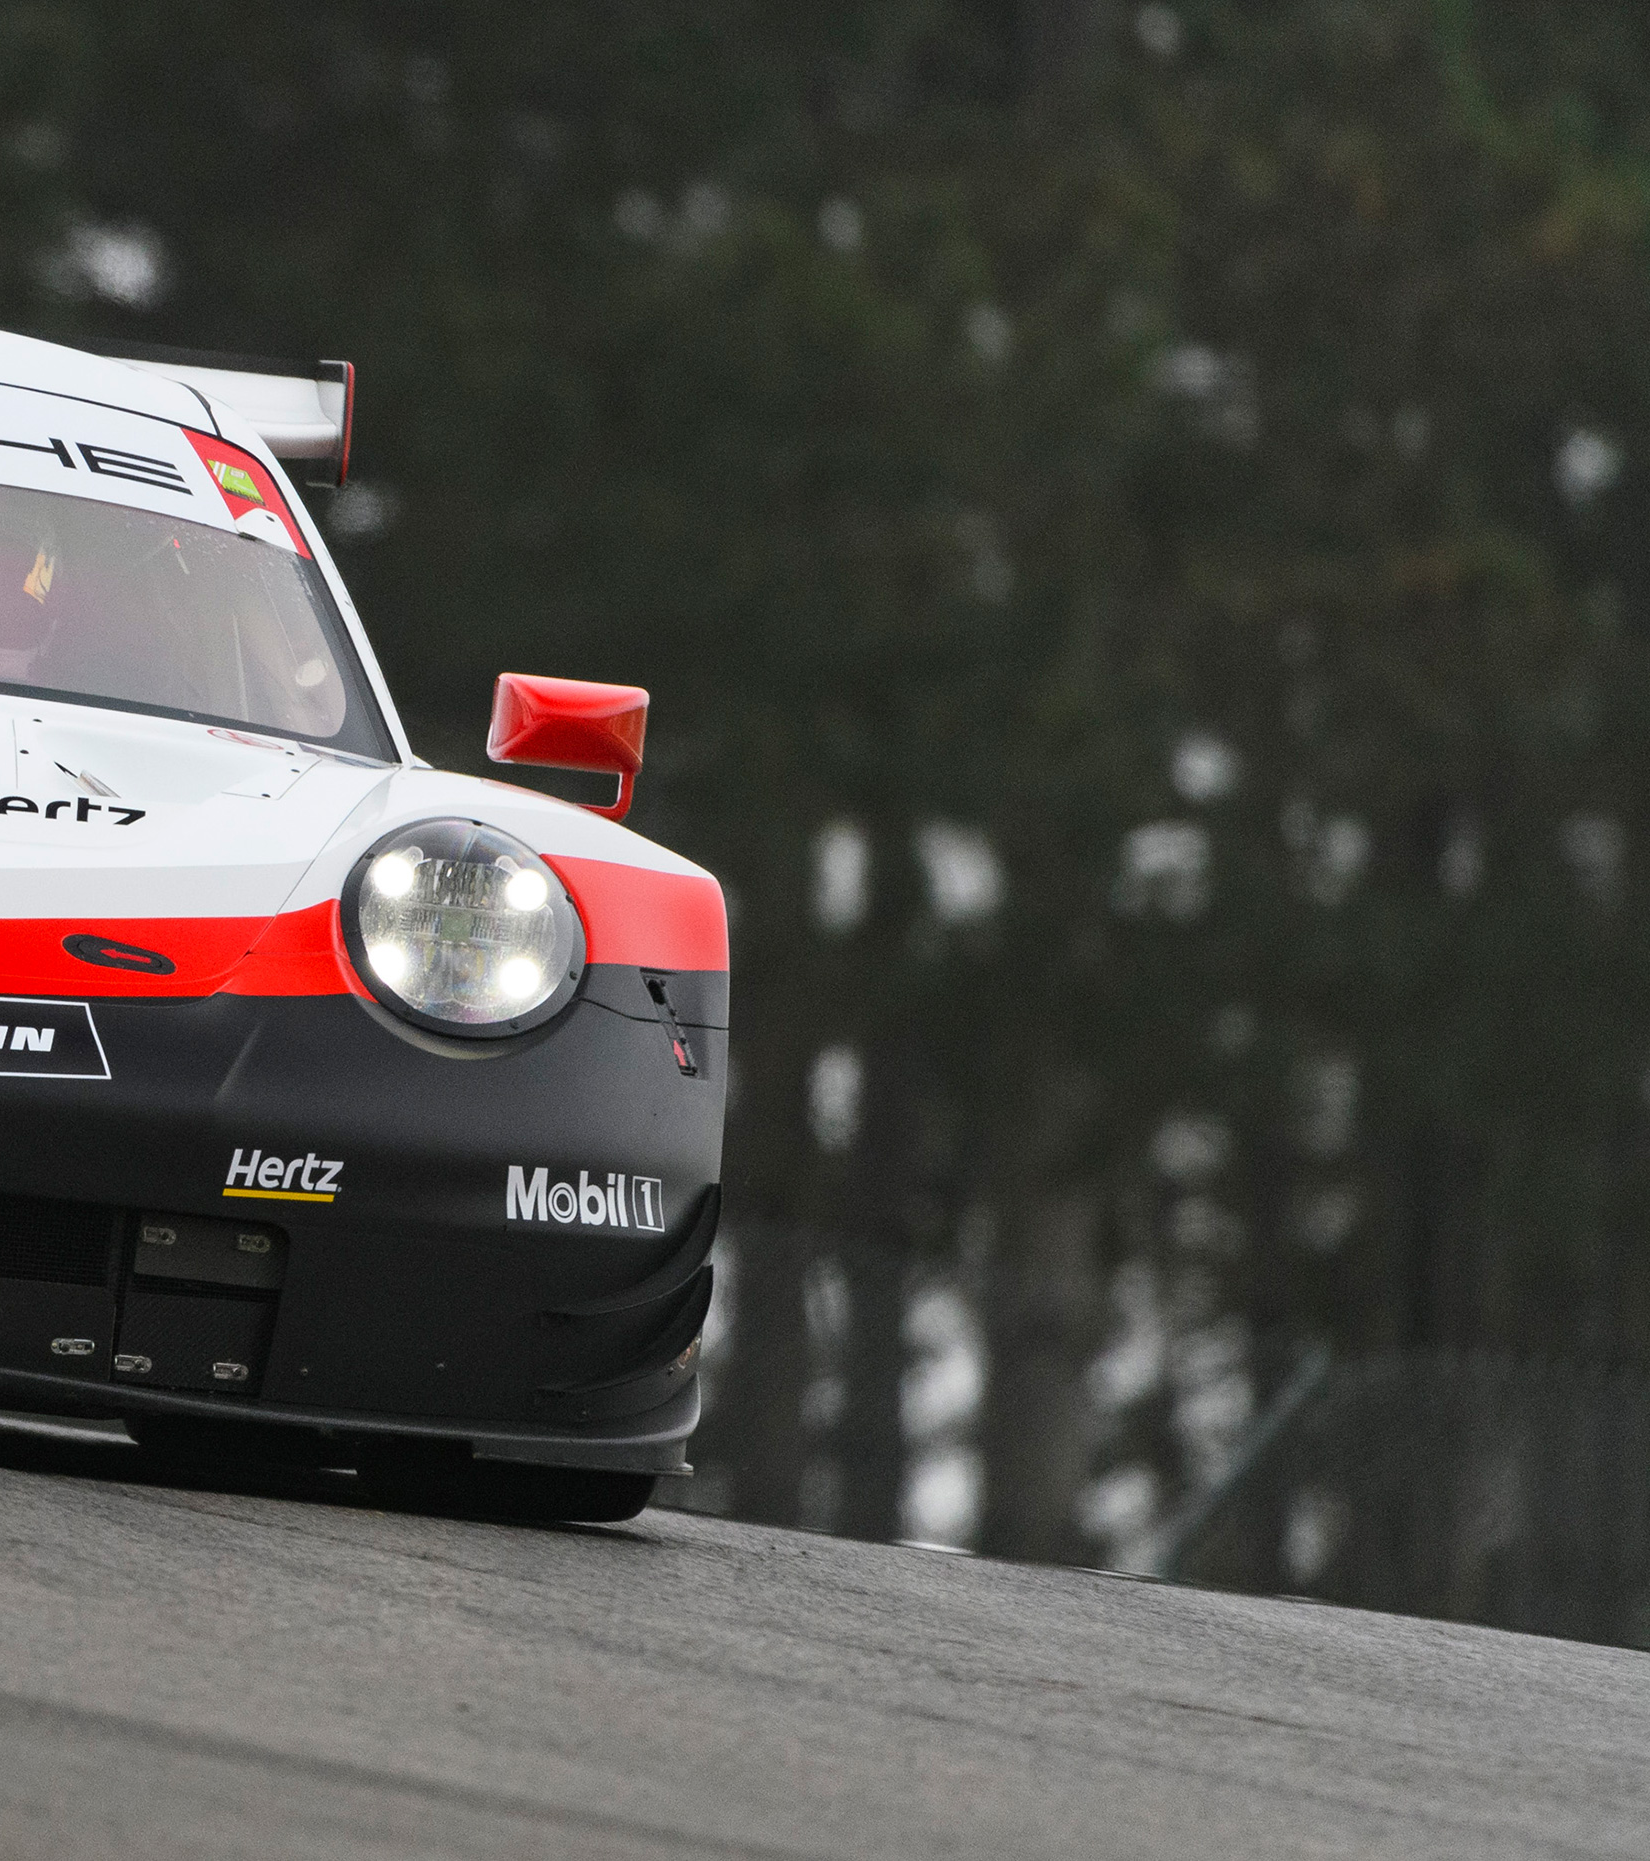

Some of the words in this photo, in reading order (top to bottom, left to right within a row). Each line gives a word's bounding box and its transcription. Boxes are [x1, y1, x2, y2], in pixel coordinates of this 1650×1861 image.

[225, 1148, 344, 1192] Hertz
[507, 1165, 629, 1227] Mobil
[640, 1182, 655, 1226] 1
